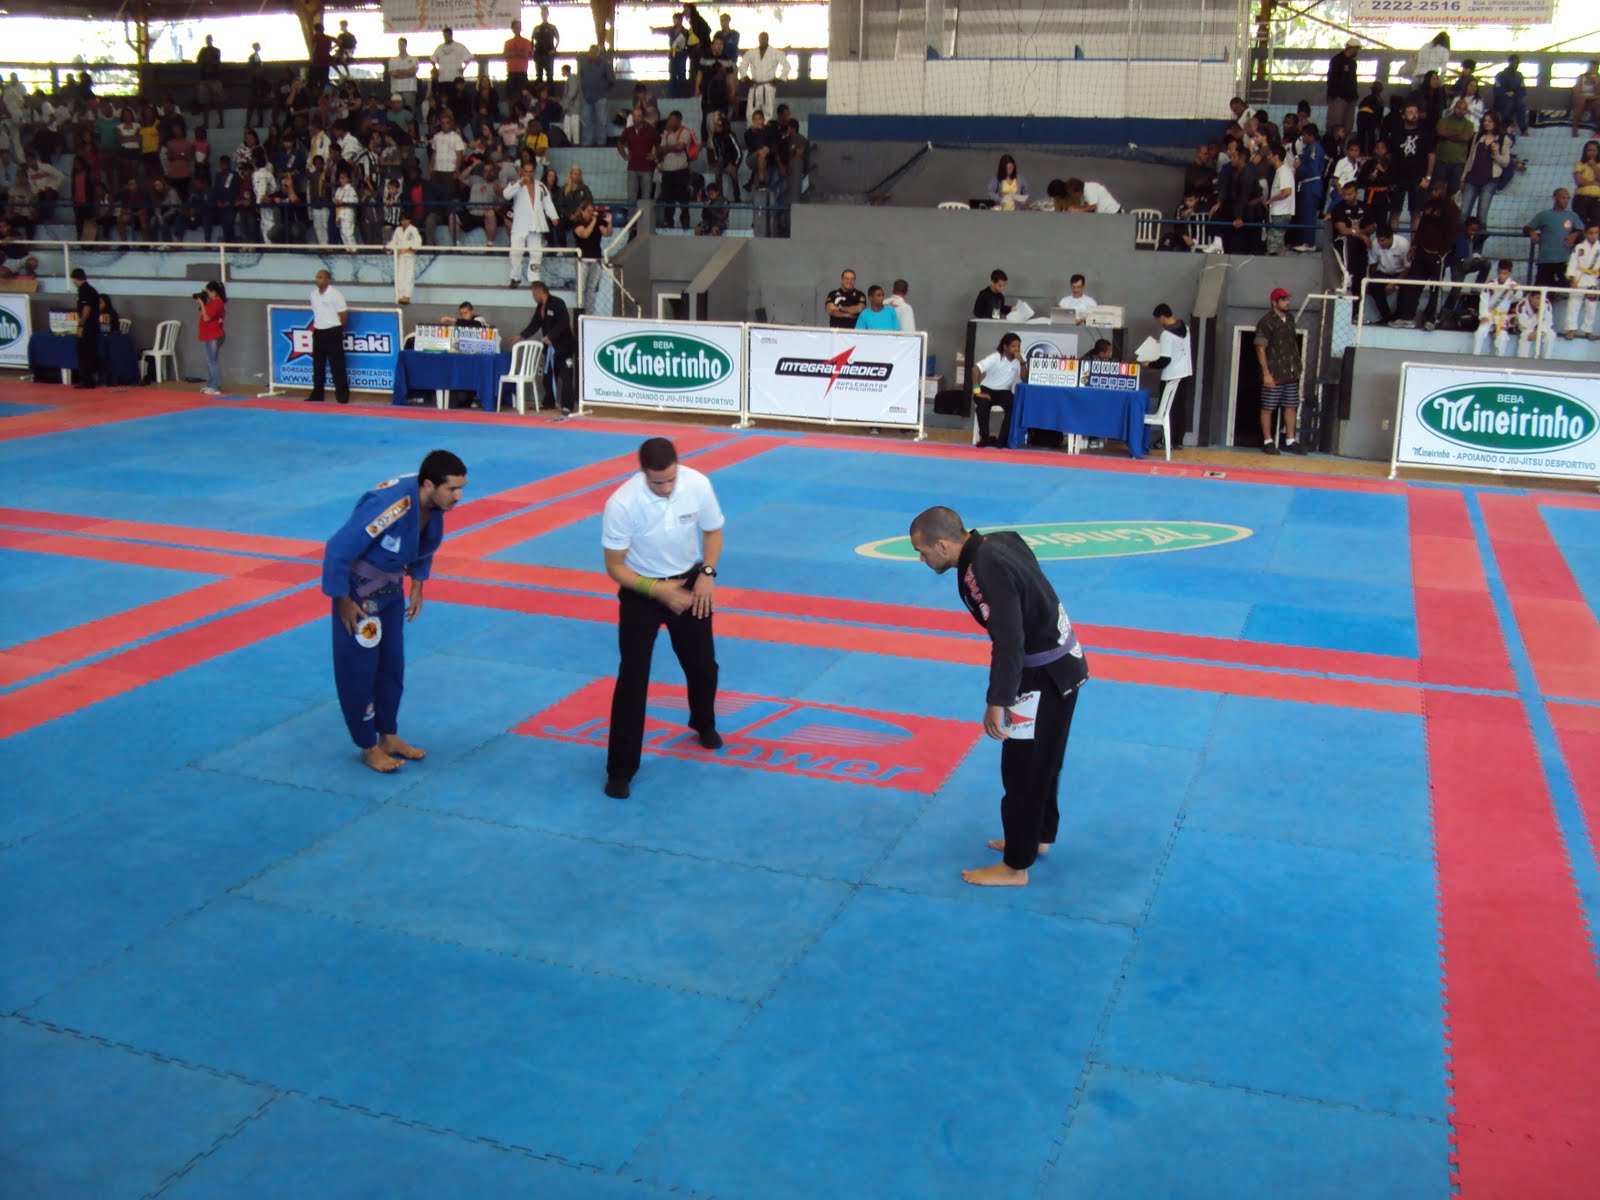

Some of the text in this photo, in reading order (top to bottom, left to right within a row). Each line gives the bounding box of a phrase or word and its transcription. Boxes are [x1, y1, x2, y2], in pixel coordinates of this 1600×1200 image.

[1371, 0, 1461, 11] 2222-2516
[293, 330, 390, 353] Bdaki
[653, 340, 674, 350] BEBA
[605, 342, 722, 380] Mineirinho
[628, 391, 659, 401] APOIANDO
[666, 394, 694, 403] JIU-JITSU
[695, 397, 734, 406] DESPORTIVO
[1496, 393, 1525, 404] BEBA
[1433, 394, 1585, 440] Mineirinho
[1412, 447, 1451, 459] Mineirinho
[1457, 452, 1498, 463] APOIANDO
[1499, 455, 1506, 464] O
[1506, 456, 1544, 467] JIU-JITSU
[1545, 460, 1596, 470] DESPORTIVO
